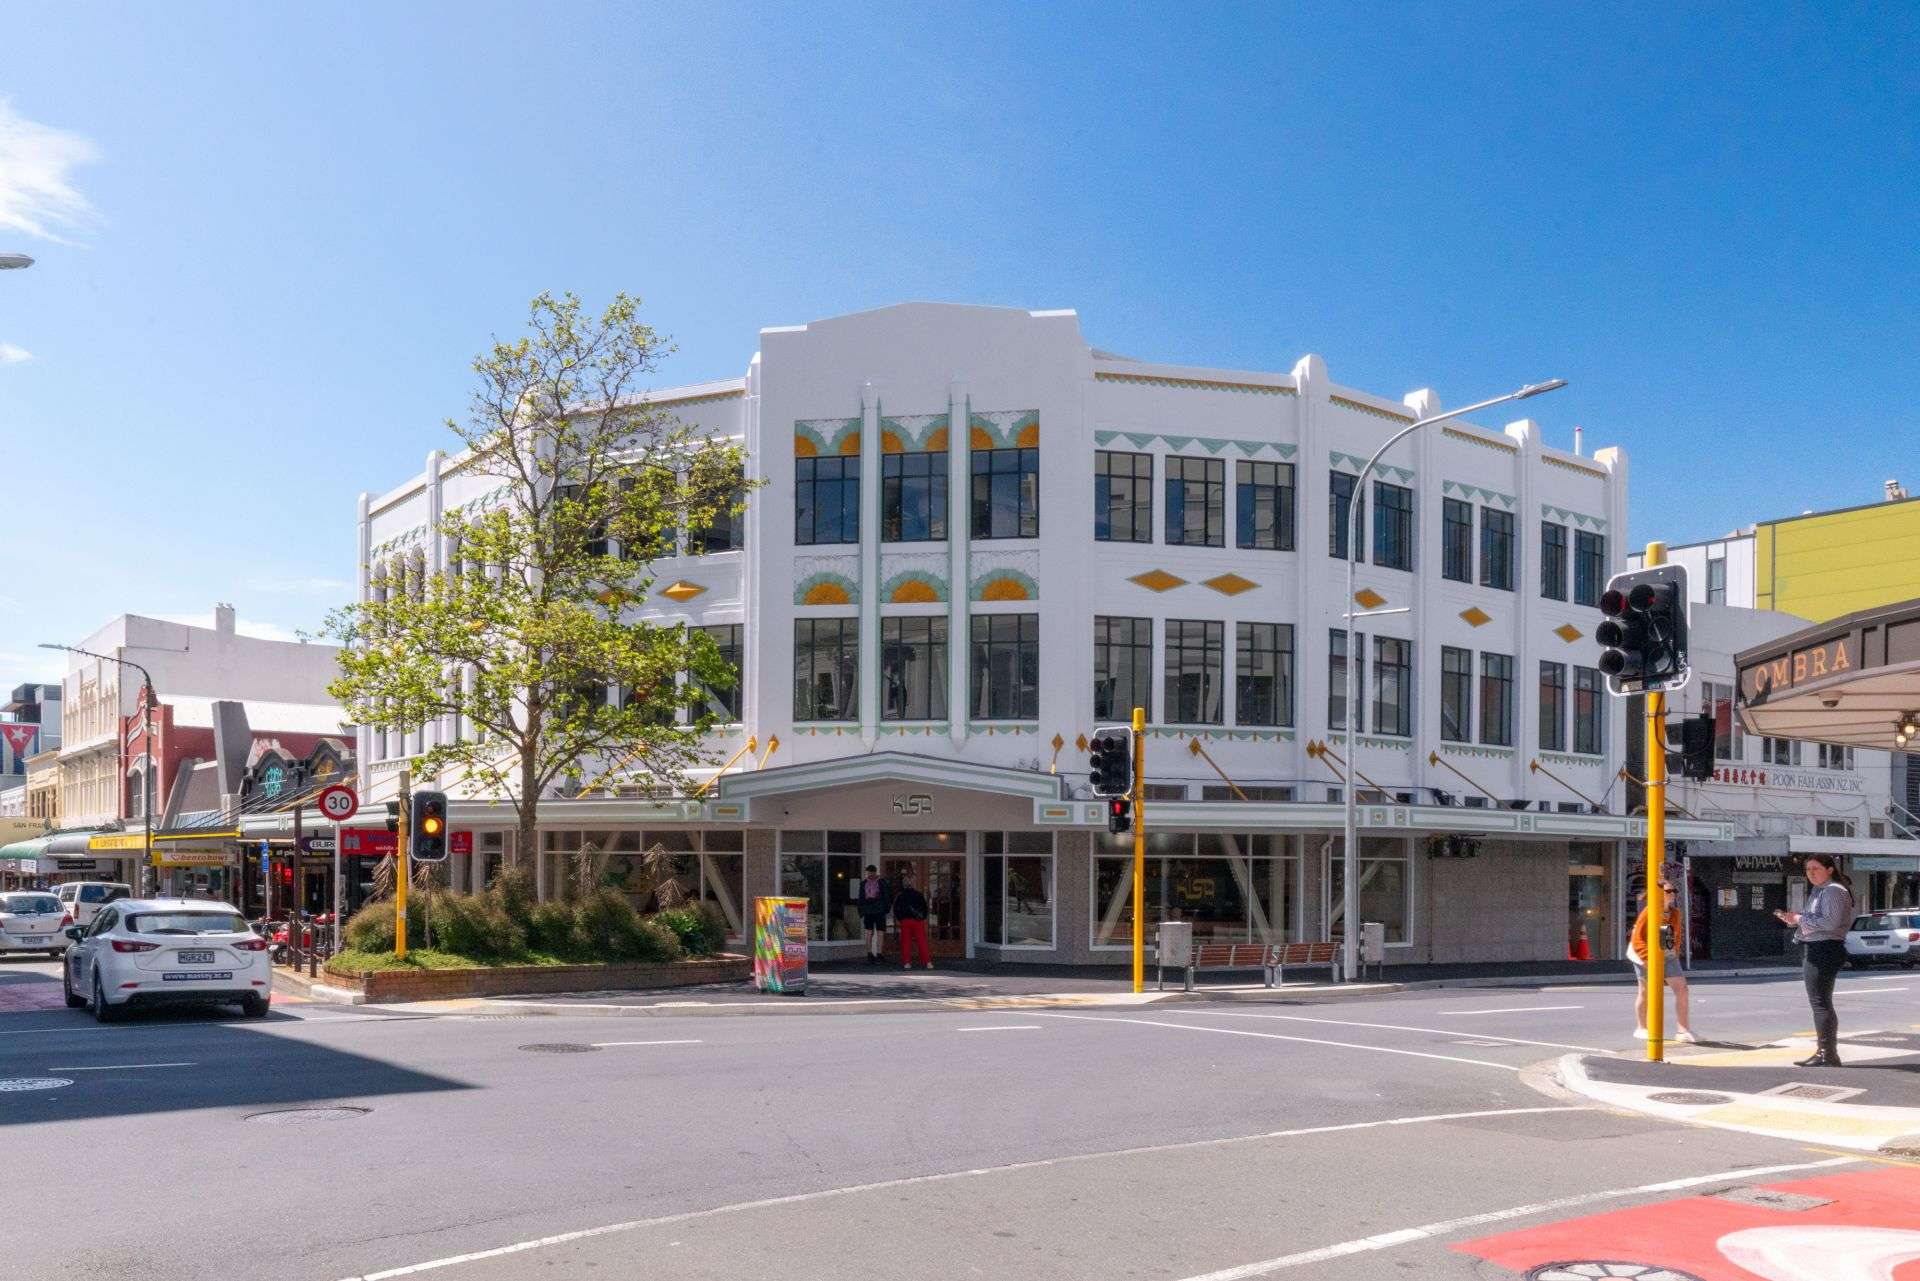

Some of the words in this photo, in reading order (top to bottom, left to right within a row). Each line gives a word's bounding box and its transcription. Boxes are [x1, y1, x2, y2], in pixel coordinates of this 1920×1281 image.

[1755, 641, 1850, 690] OMBRA
[1773, 773, 1796, 786] POON
[1799, 775, 1815, 788] FAH
[328, 796, 350, 810] 30
[1735, 855, 1783, 871] VALHALLA
